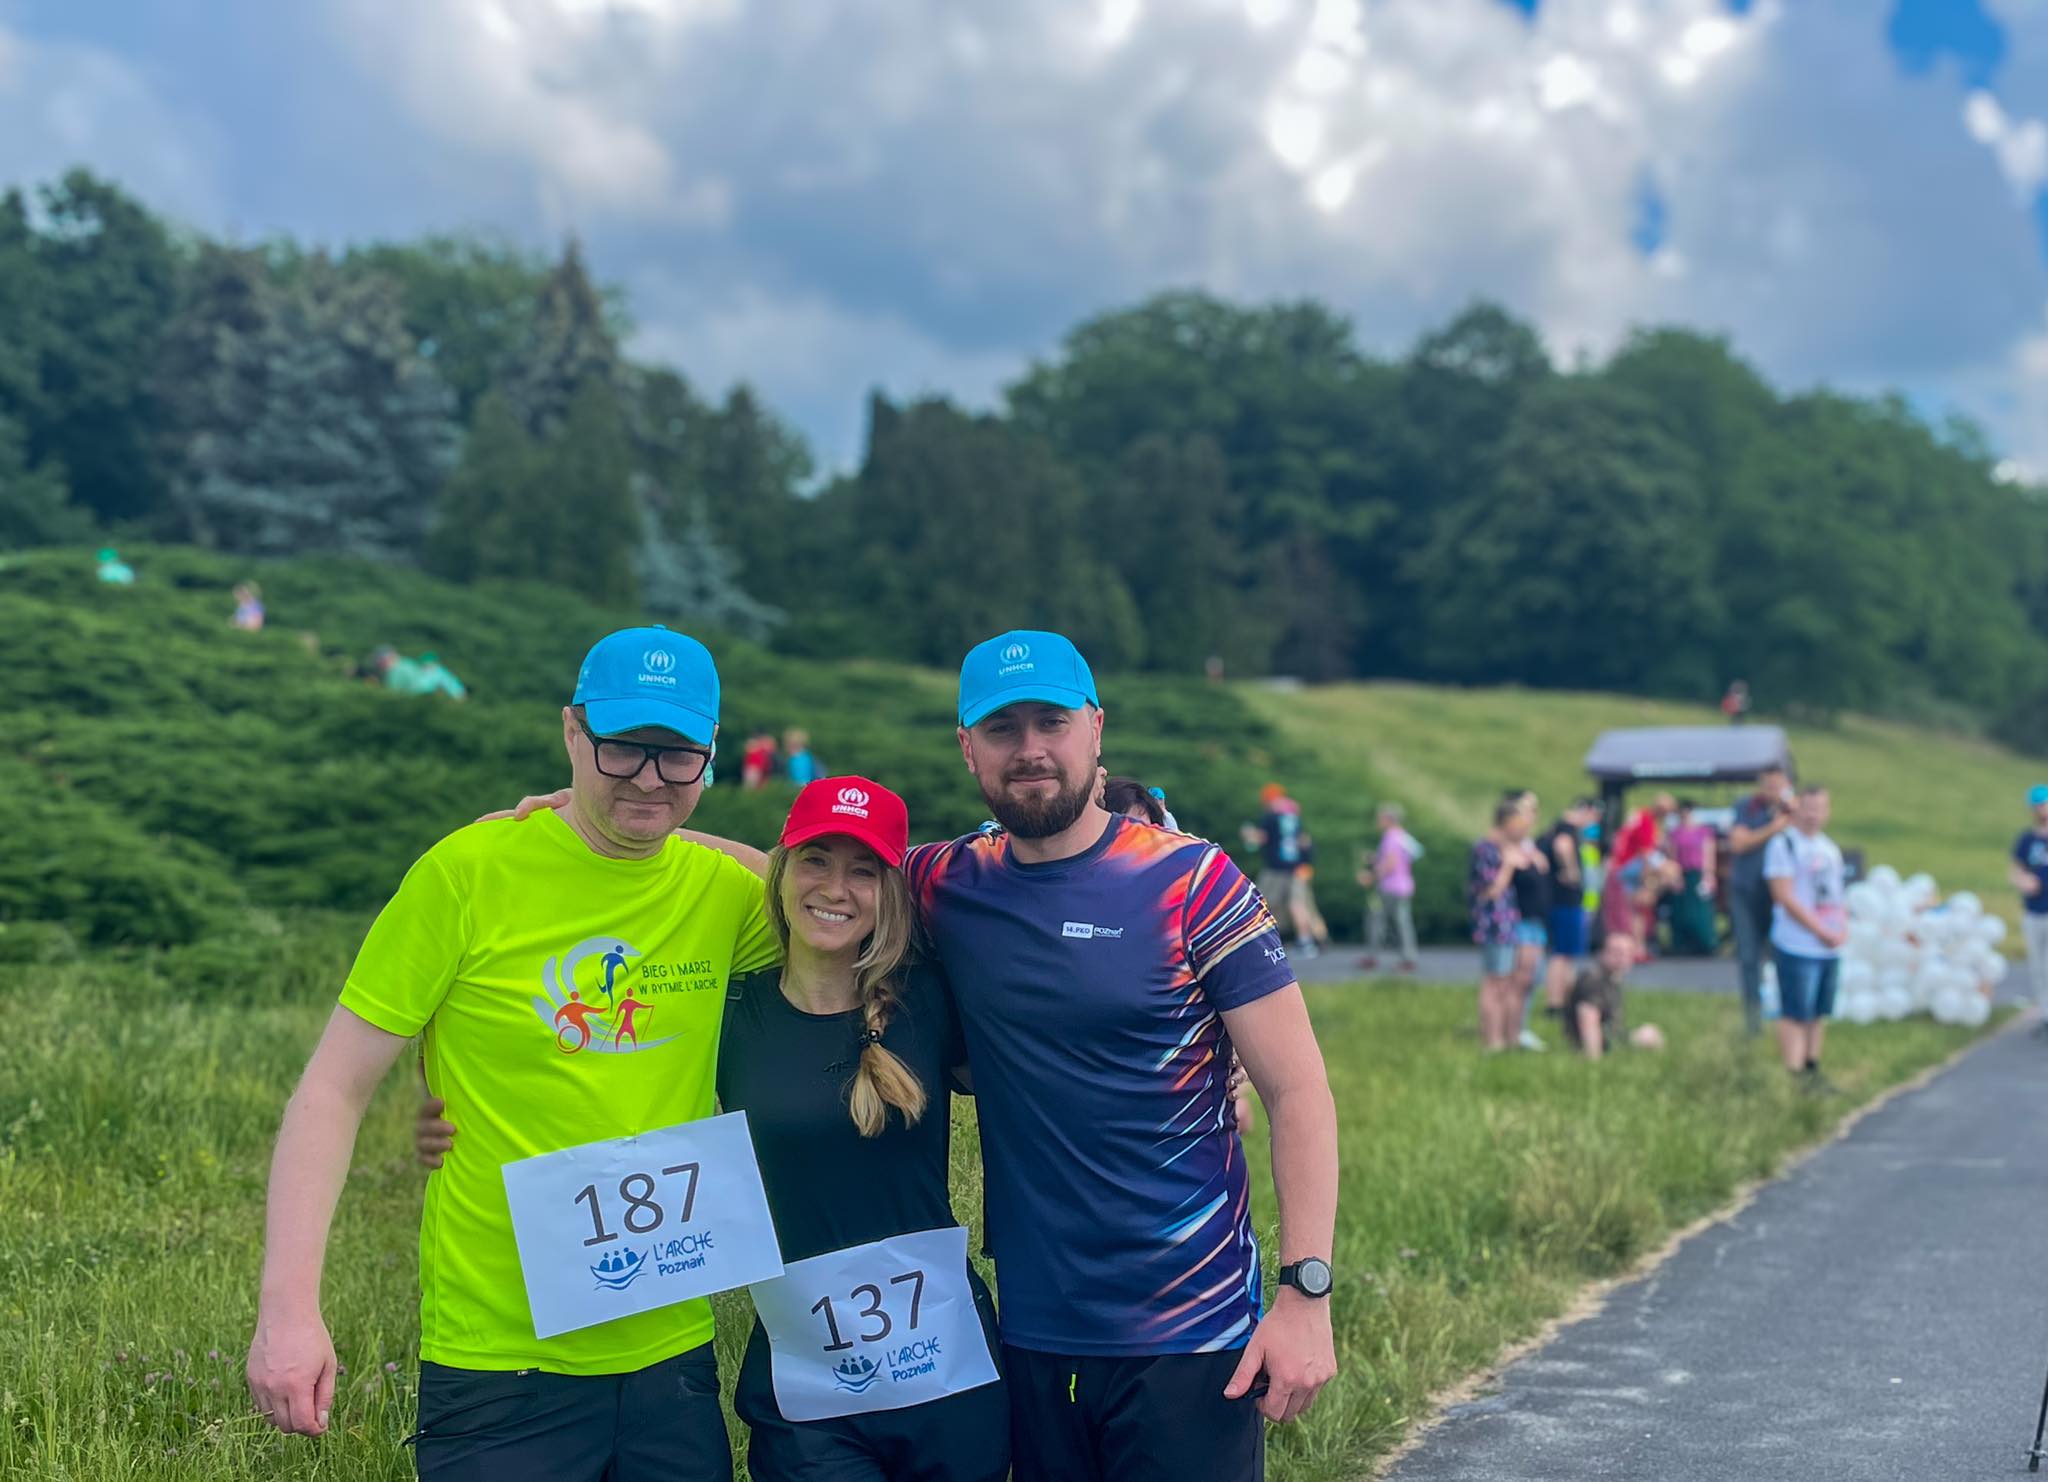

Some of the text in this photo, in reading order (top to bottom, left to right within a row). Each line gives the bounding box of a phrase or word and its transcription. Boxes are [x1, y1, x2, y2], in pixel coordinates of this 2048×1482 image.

[638, 673, 677, 685] UNHCR
[998, 662, 1034, 675] UNHCR
[831, 804, 869, 817] UNHCR
[641, 960, 713, 978] BIEG I MARSZ
[639, 978, 719, 995] W RYTMIE L'ARCHE
[574, 1161, 700, 1247] 187
[653, 1231, 715, 1262] L'ARCHE
[657, 1252, 706, 1277] Poznań
[811, 1269, 924, 1352] 137
[886, 1336, 942, 1368] L'ARCHE
[891, 1357, 937, 1382] Poznań
